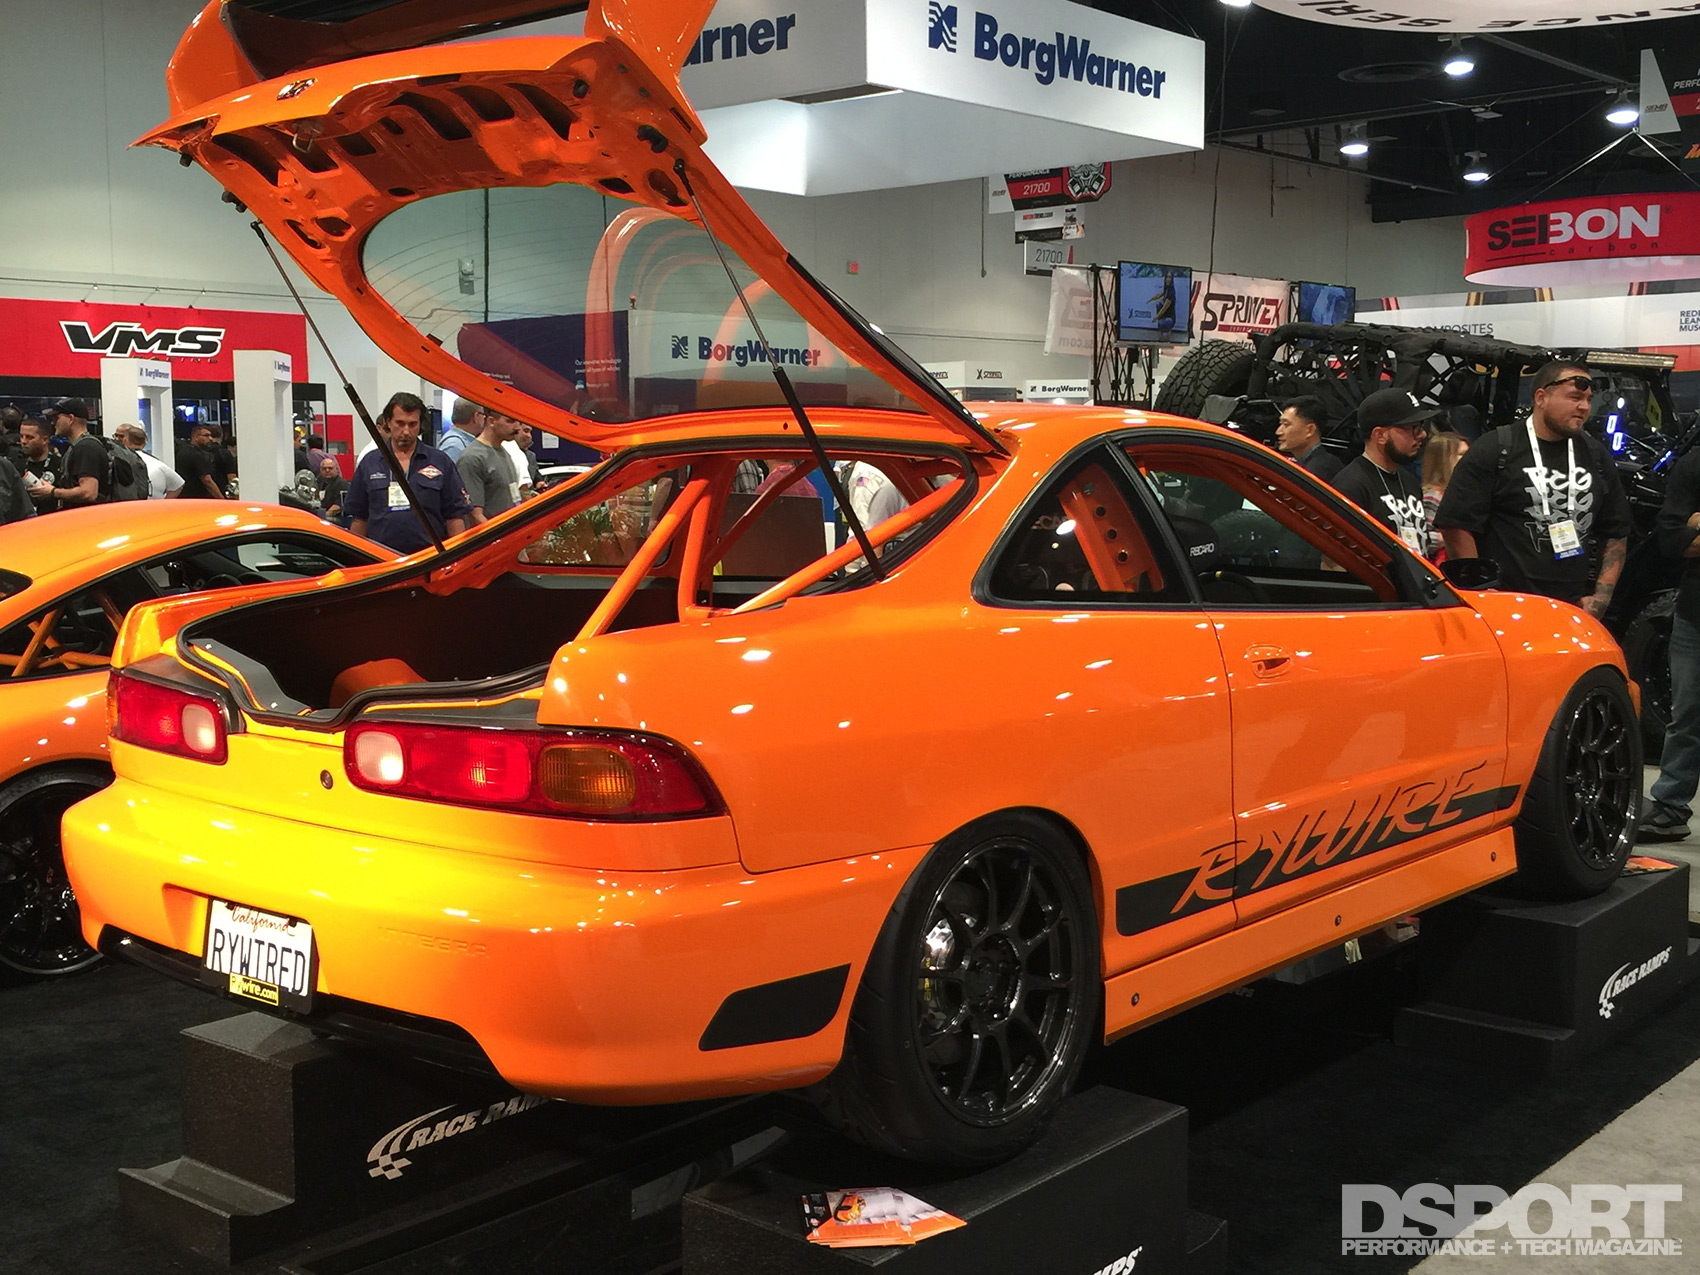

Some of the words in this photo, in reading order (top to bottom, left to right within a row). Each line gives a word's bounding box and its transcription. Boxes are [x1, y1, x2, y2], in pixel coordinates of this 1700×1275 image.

[974, 11, 1166, 99] BorgWarner
[1023, 182, 1051, 196] 21700
[1487, 205, 1660, 251] SEIBON
[1035, 248, 1063, 264] 21700
[1549, 241, 1659, 256] carbon
[59, 320, 226, 358] VMS
[1041, 385, 1088, 393] BorgWarne
[1190, 543, 1215, 557] RECARO
[1170, 760, 1487, 914] RYWIRE
[232, 905, 295, 937] California
[406, 1110, 481, 1152] RACE
[482, 1094, 547, 1126] RAM
